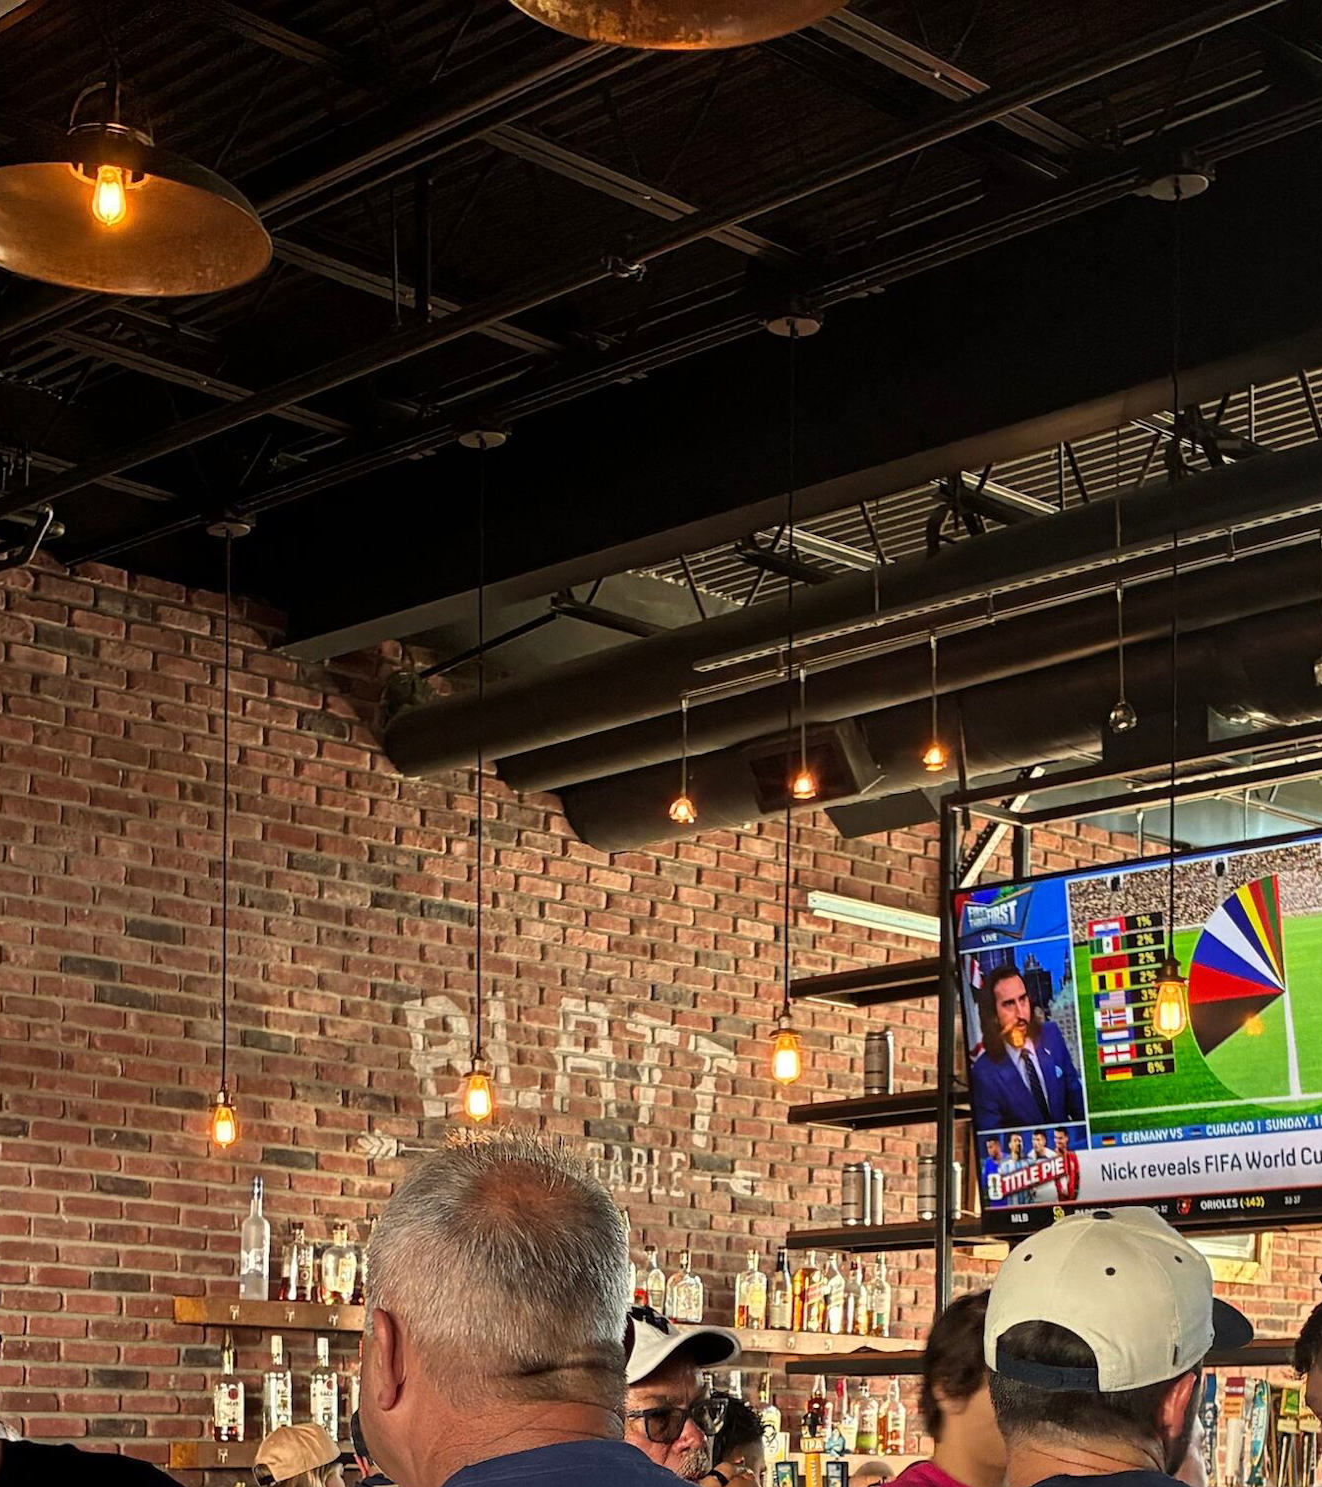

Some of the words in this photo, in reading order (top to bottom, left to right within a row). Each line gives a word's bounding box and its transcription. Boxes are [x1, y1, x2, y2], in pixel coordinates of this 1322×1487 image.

[1136, 915, 1153, 927] 1%
[1136, 933, 1155, 946] 2%
[1138, 951, 1156, 964] 2%
[1145, 1042, 1164, 1055] 6%
[1121, 1128, 1168, 1145] GERMANY
[1169, 1127, 1184, 1140] VS
[1206, 1120, 1255, 1137] CURAÇAO
[586, 1141, 687, 1198] TABLE
[1101, 1161, 1138, 1182] Nick
[1141, 1156, 1201, 1178] reveals
[1205, 1153, 1242, 1174] FIFA
[1246, 1147, 1297, 1170] World
[1003, 1165, 1040, 1193] TITLE
[1041, 1156, 1065, 1180] PIE
[1200, 1197, 1239, 1210] ORIOLES
[1011, 1213, 1029, 1224] MLB
[803, 1440, 823, 1452] IPA
